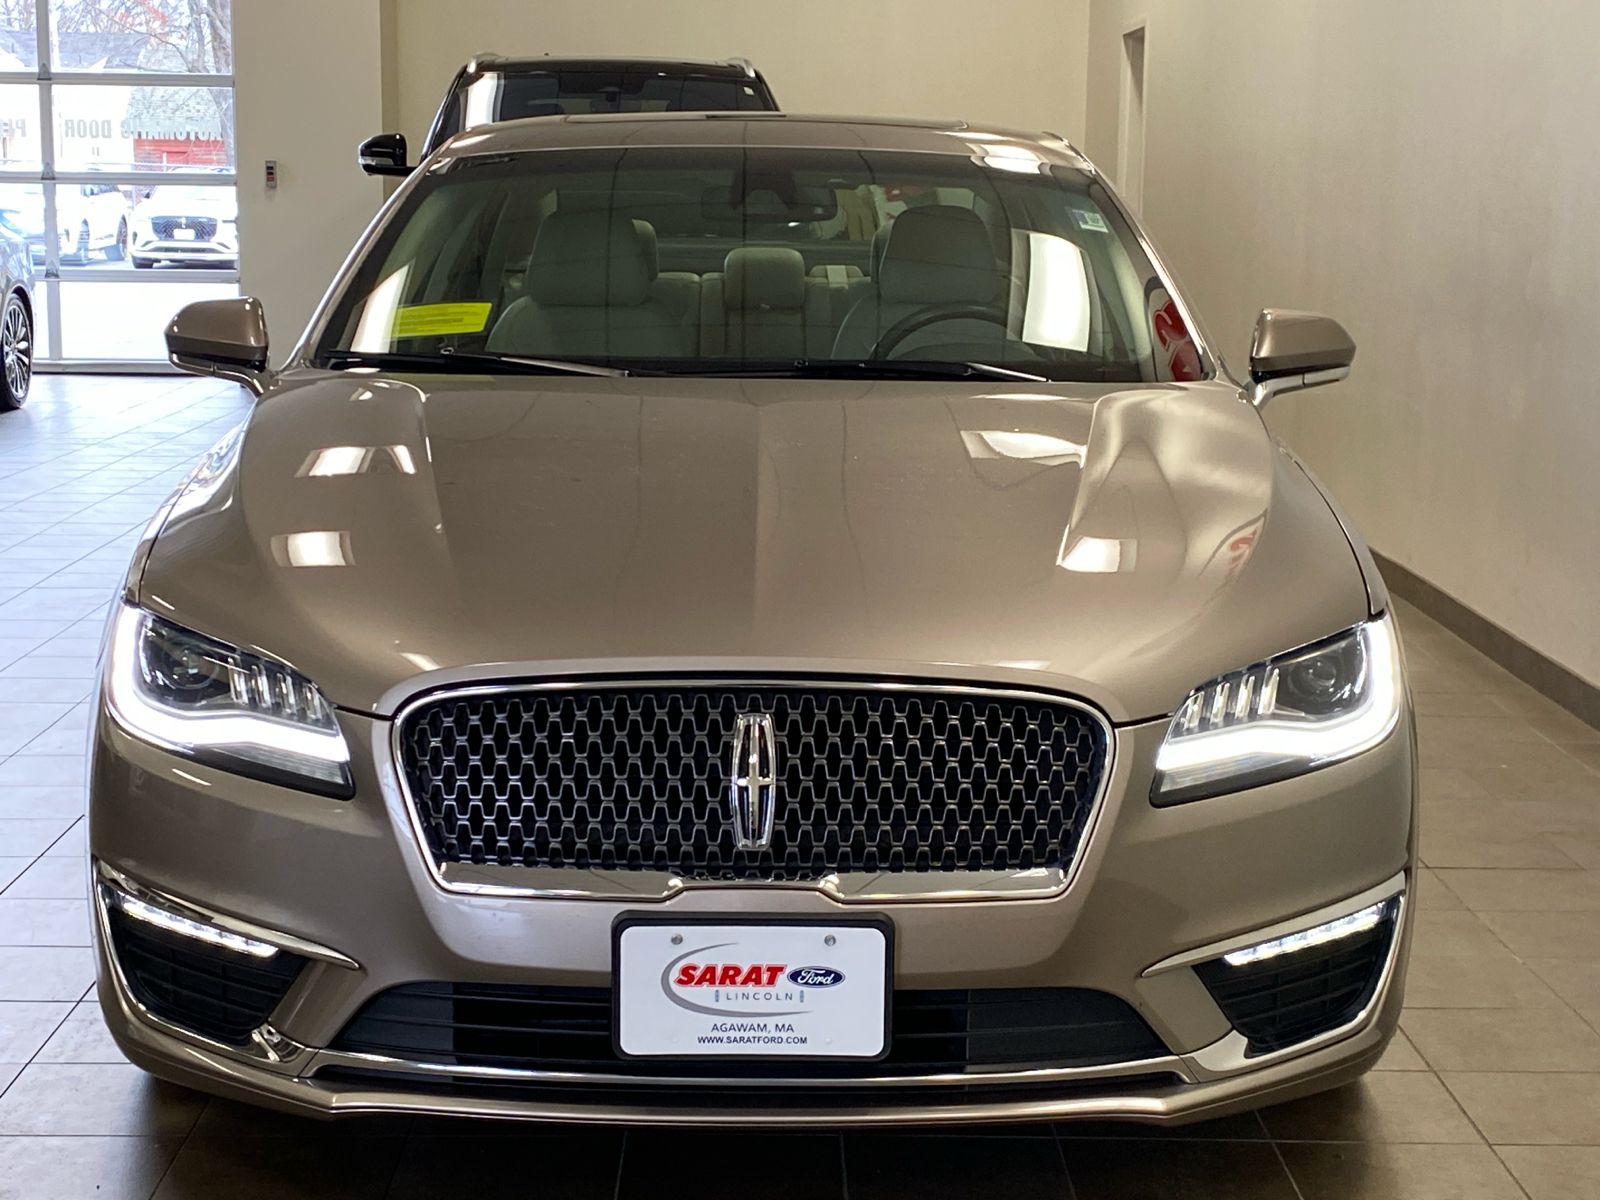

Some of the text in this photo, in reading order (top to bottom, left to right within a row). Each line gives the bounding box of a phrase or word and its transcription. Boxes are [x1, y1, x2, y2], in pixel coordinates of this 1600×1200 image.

[673, 963, 836, 988] SARAT Ford
[726, 992, 794, 1001] LINCOLN
[711, 1023, 795, 1034] AGAWAM, MA
[697, 1036, 808, 1045] WWW.SARATFORD.COM
